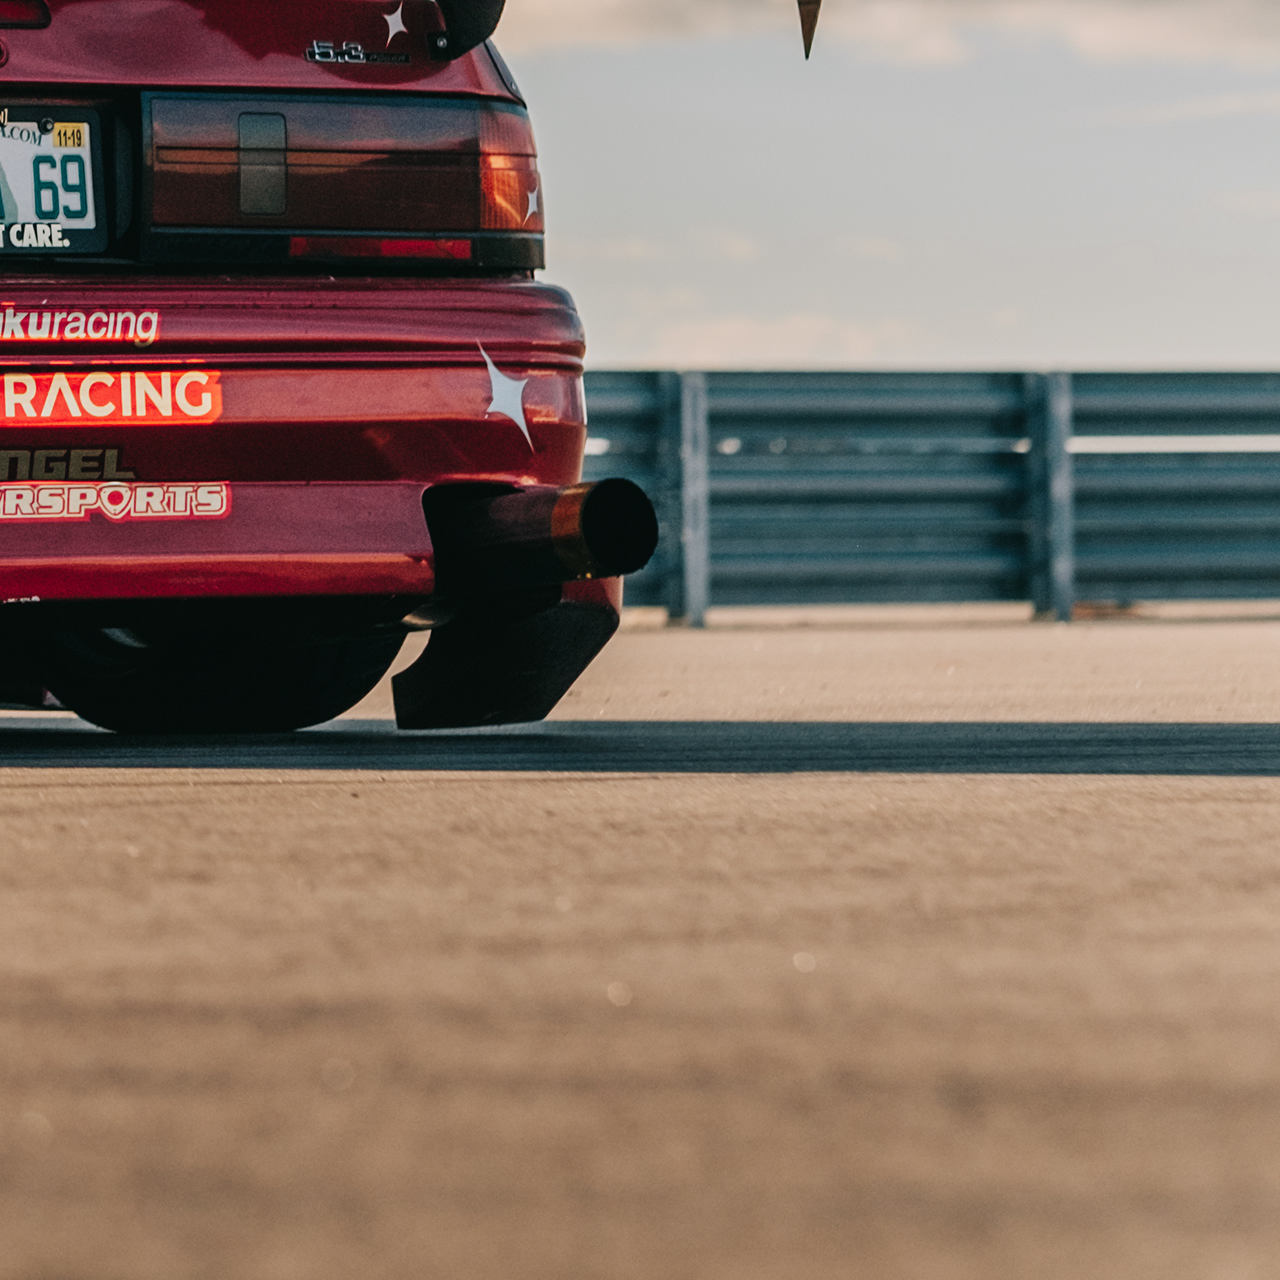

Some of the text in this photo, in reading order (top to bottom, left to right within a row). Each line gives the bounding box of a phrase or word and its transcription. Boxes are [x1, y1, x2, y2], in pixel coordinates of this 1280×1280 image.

[313, 40, 366, 63] 5.3
[57, 129, 82, 148] 11-19
[32, 154, 88, 220] 69
[9, 223, 71, 248] CARE.
